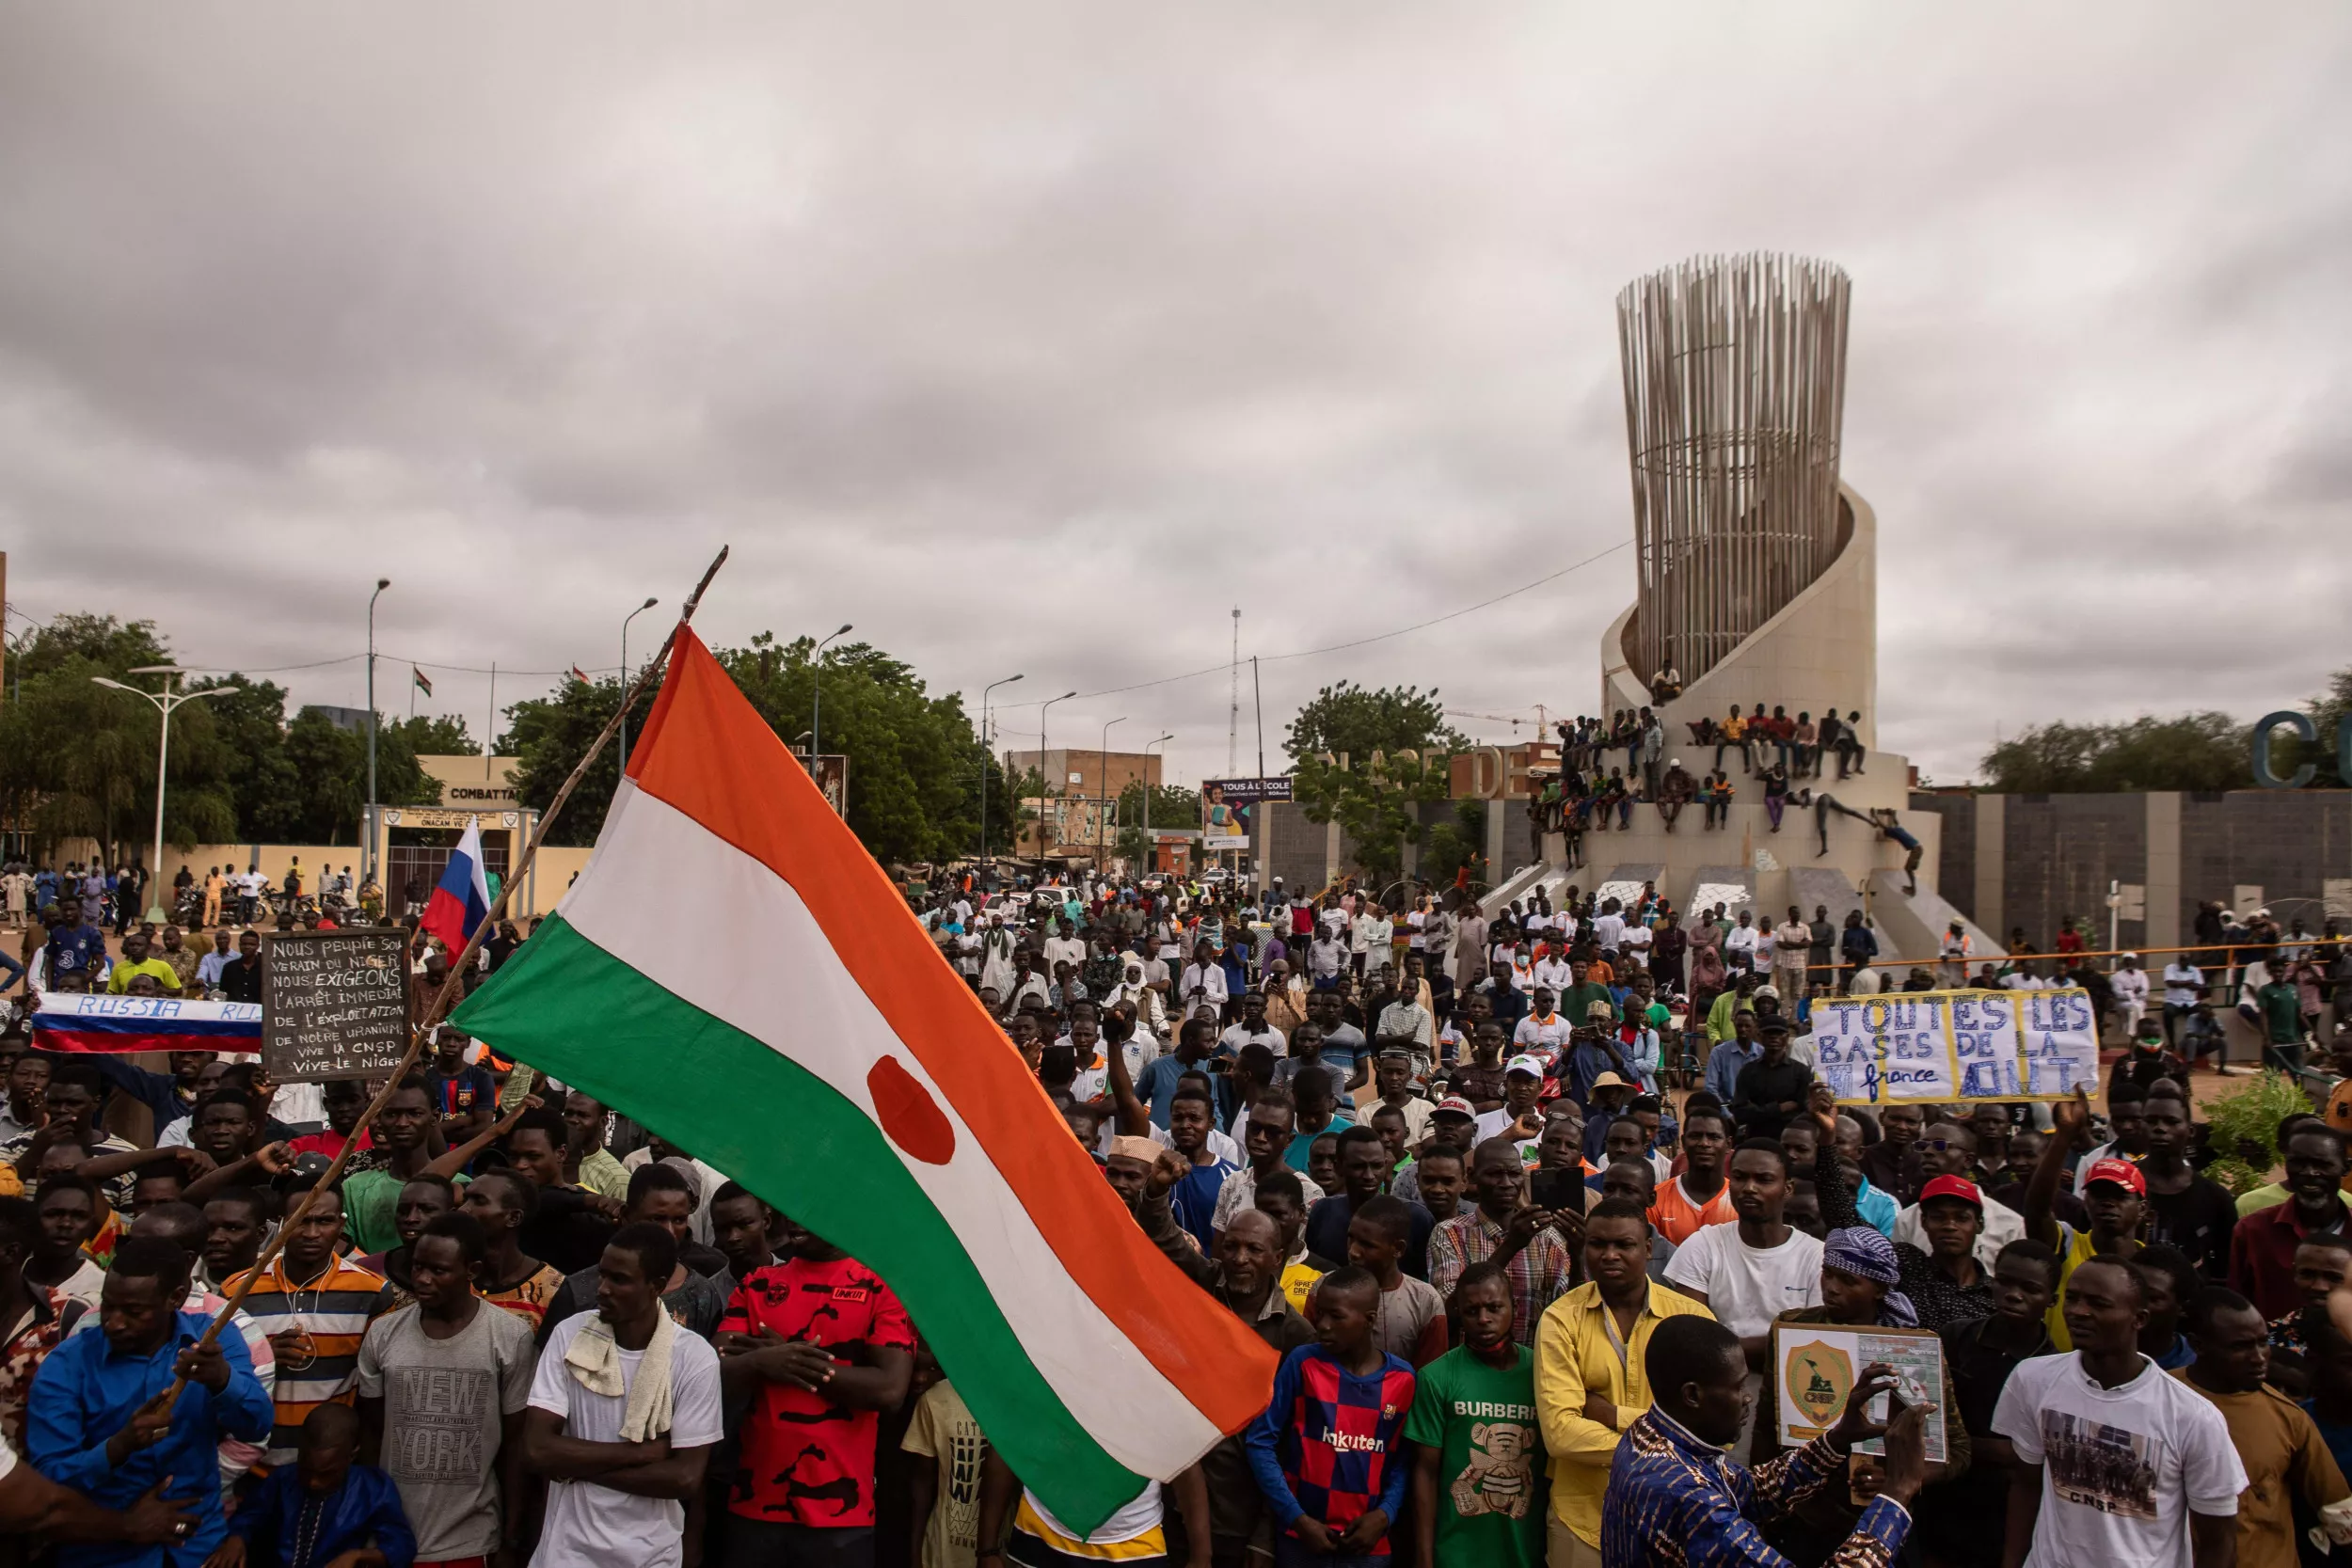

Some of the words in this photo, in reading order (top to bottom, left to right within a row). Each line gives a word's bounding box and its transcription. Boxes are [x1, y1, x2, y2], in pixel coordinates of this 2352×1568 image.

[2253, 711, 2352, 789] C
[1473, 745, 1531, 800] DE
[1248, 781, 1254, 790] À
[273, 942, 314, 958] NOUS
[271, 958, 321, 972] VERAIN
[326, 958, 342, 970] DU
[273, 975, 310, 988] NOUS
[315, 970, 401, 987] EXIGEONS
[77, 995, 183, 1018] RUSSIA
[1829, 993, 2008, 1036] TOUTES
[2032, 993, 2090, 1033] LES
[275, 1017, 297, 1027] DE
[275, 1036, 294, 1047] DE
[297, 1046, 325, 1058] VIVE
[334, 1043, 345, 1054] LA
[352, 1040, 397, 1053] CNSP
[1820, 1032, 1934, 1064] BASES
[1957, 1032, 1995, 1058] DE
[2016, 1031, 2060, 1058] LA
[293, 1060, 330, 1073] VIVE
[336, 1056, 352, 1069] LE
[361, 1053, 403, 1069] NIGER
[1860, 1063, 1939, 1102] france
[834, 1289, 864, 1299] UNKUT
[402, 1370, 484, 1415] NEW
[1803, 1392, 1836, 1404] CNSP
[394, 1426, 483, 1471] YORK
[2070, 1492, 2117, 1513] CNSP
